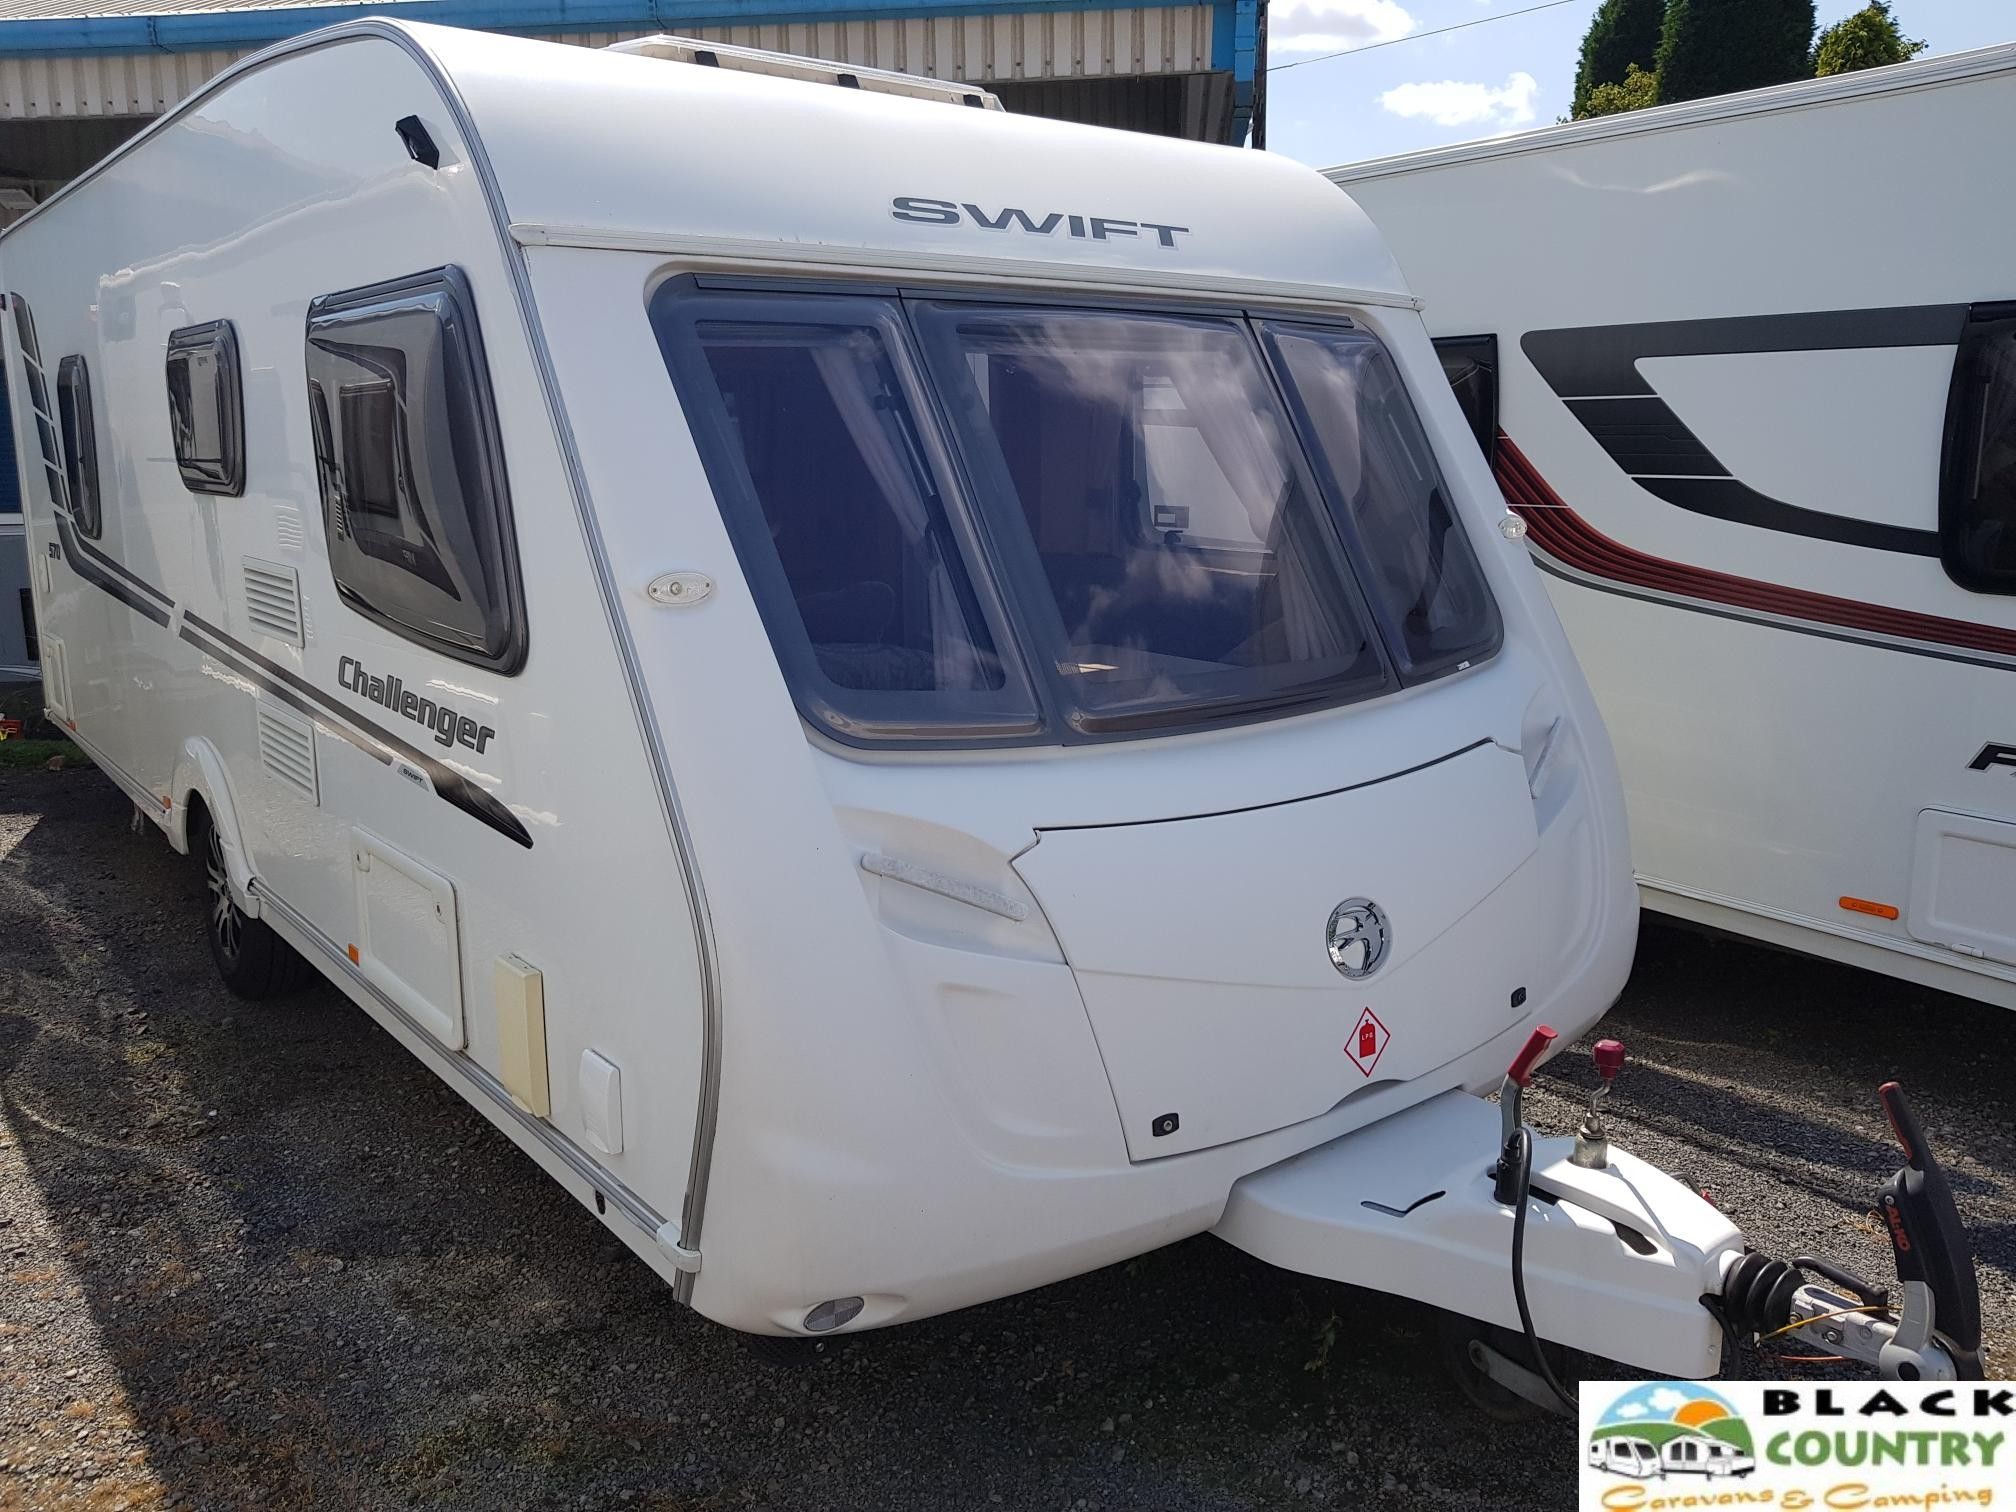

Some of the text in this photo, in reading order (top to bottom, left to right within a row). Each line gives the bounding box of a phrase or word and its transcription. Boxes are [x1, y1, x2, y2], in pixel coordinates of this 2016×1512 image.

[892, 197, 1190, 247] SWIFT
[338, 655, 495, 755] Challenger
[402, 768, 424, 783] SWIFT
